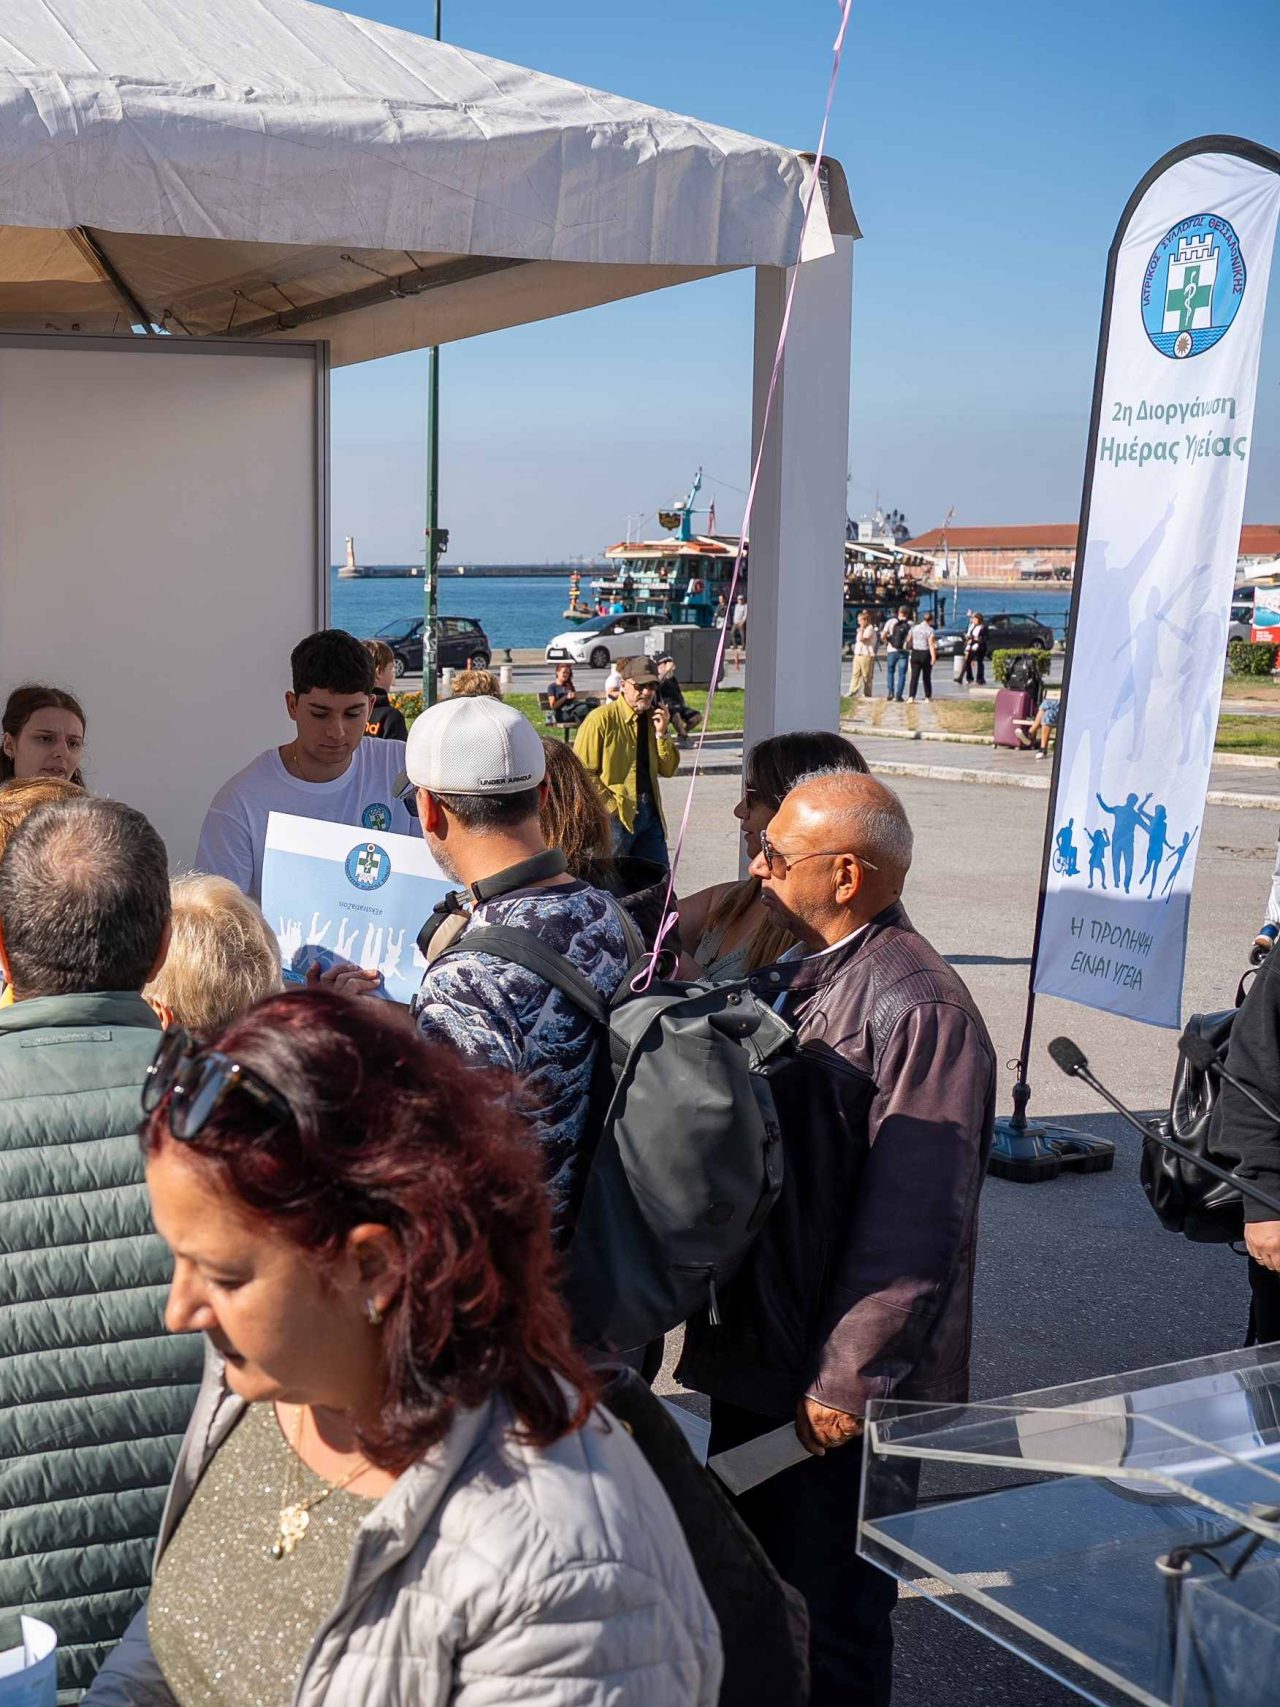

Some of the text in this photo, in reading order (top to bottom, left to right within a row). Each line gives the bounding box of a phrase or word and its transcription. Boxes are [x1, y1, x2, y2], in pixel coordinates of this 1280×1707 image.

[1143, 253, 1161, 306] ΙΑΤΡΙΚΟΣ
[1112, 396, 1236, 426] 2η Διοργάνωση
[1100, 435, 1180, 468] Ημέρας
[1071, 917, 1153, 957] Η ΠΡΟΛΗΨΗ
[1070, 951, 1142, 990] ΕΙΝΑΙ ΥΓΕΙΑ
